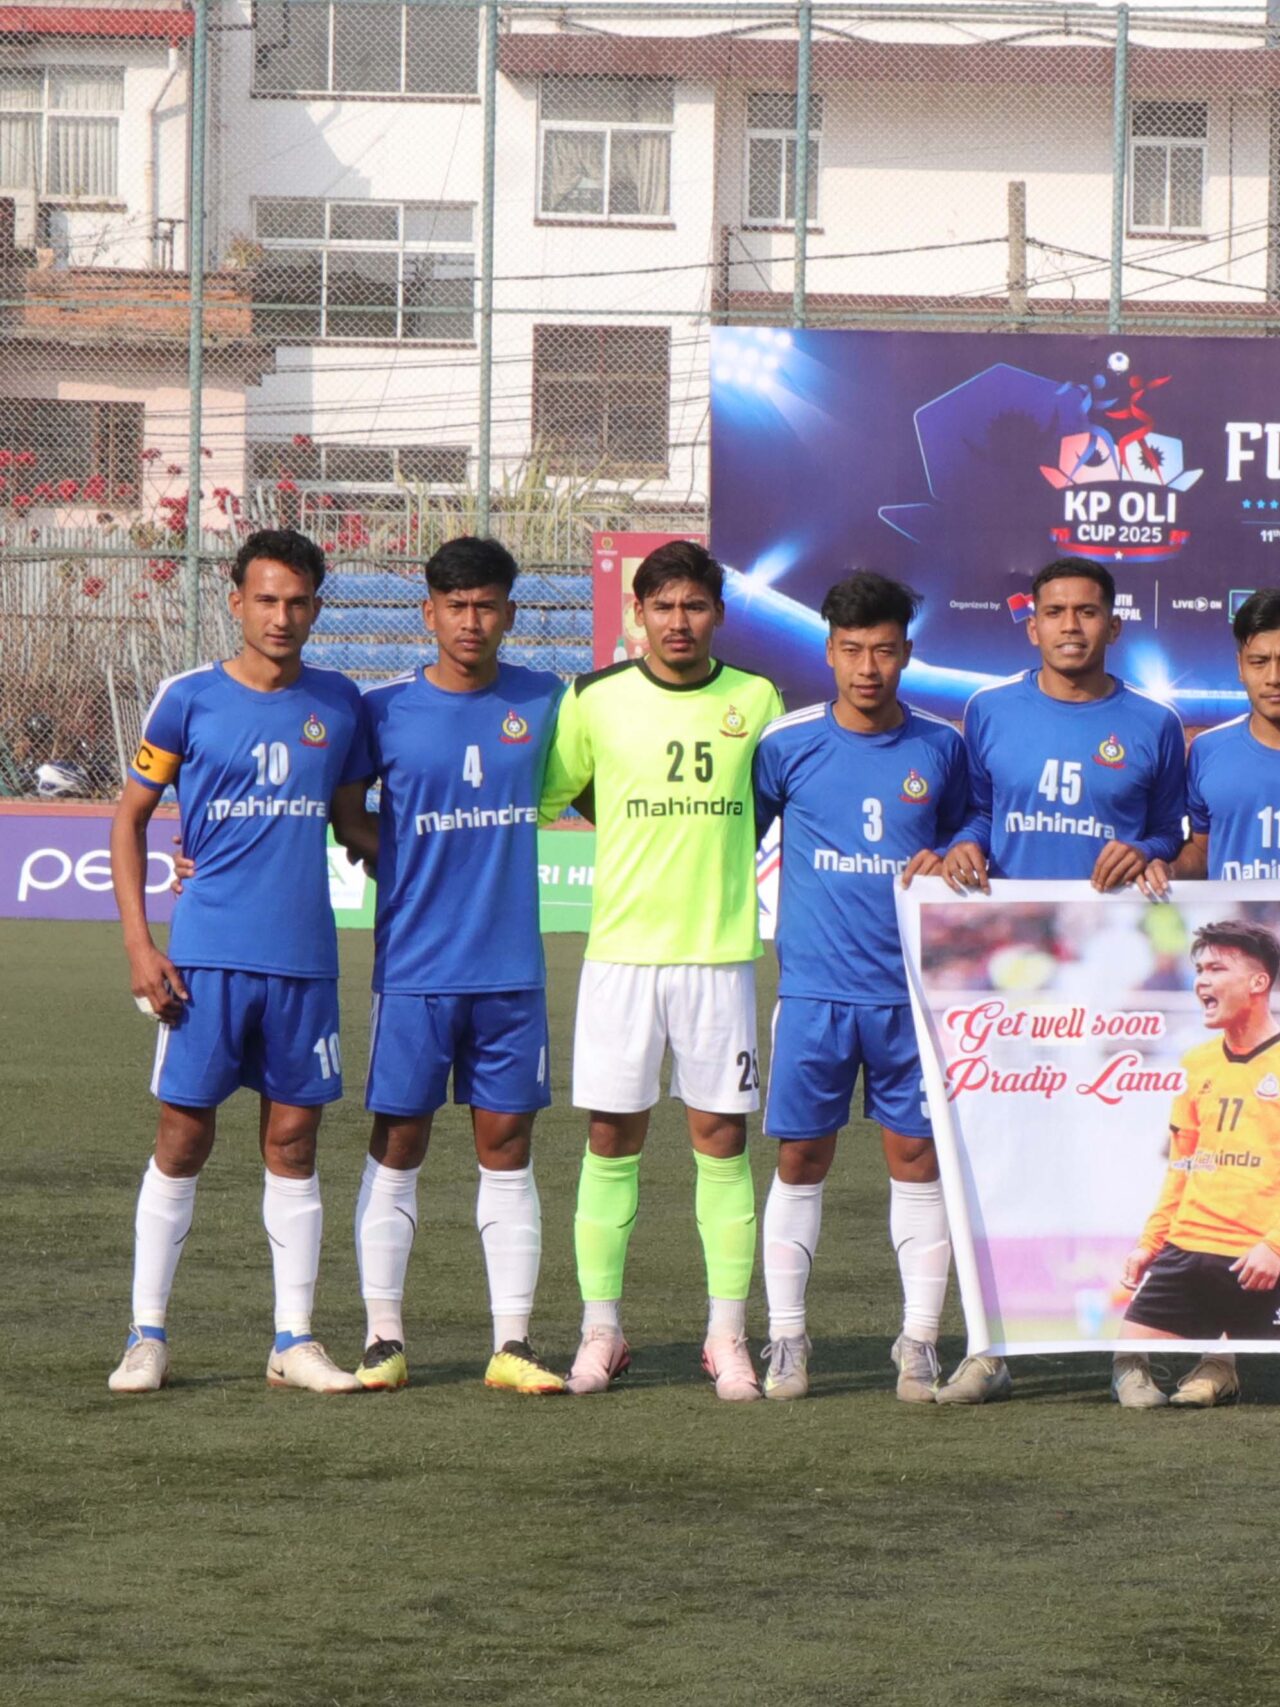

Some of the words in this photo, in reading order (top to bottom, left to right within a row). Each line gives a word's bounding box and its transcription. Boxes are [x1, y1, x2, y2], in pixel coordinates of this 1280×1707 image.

[1064, 490, 1111, 522] KP
[1118, 491, 1177, 523] OLI
[1077, 524, 1116, 542] CUP
[1118, 526, 1163, 543] 2025
[949, 600, 989, 611] Organized
[1172, 600, 1194, 609] LIVE
[1209, 601, 1222, 609] ON
[136, 745, 153, 771] C
[251, 741, 289, 786] 10
[462, 744, 483, 788] 4
[666, 740, 714, 783] 25
[1038, 759, 1082, 805] 45
[207, 795, 326, 821] Mahindra
[416, 805, 538, 835] Mahindra
[626, 797, 744, 819] Mahindra
[861, 797, 883, 842] 3
[1005, 811, 1116, 840] Mahindra
[947, 1000, 1028, 1054] Get
[1031, 1007, 1086, 1039] well
[1091, 1014, 1162, 1037] soon
[944, 1055, 1068, 1104] Pradip
[1076, 1053, 1184, 1106] Lama
